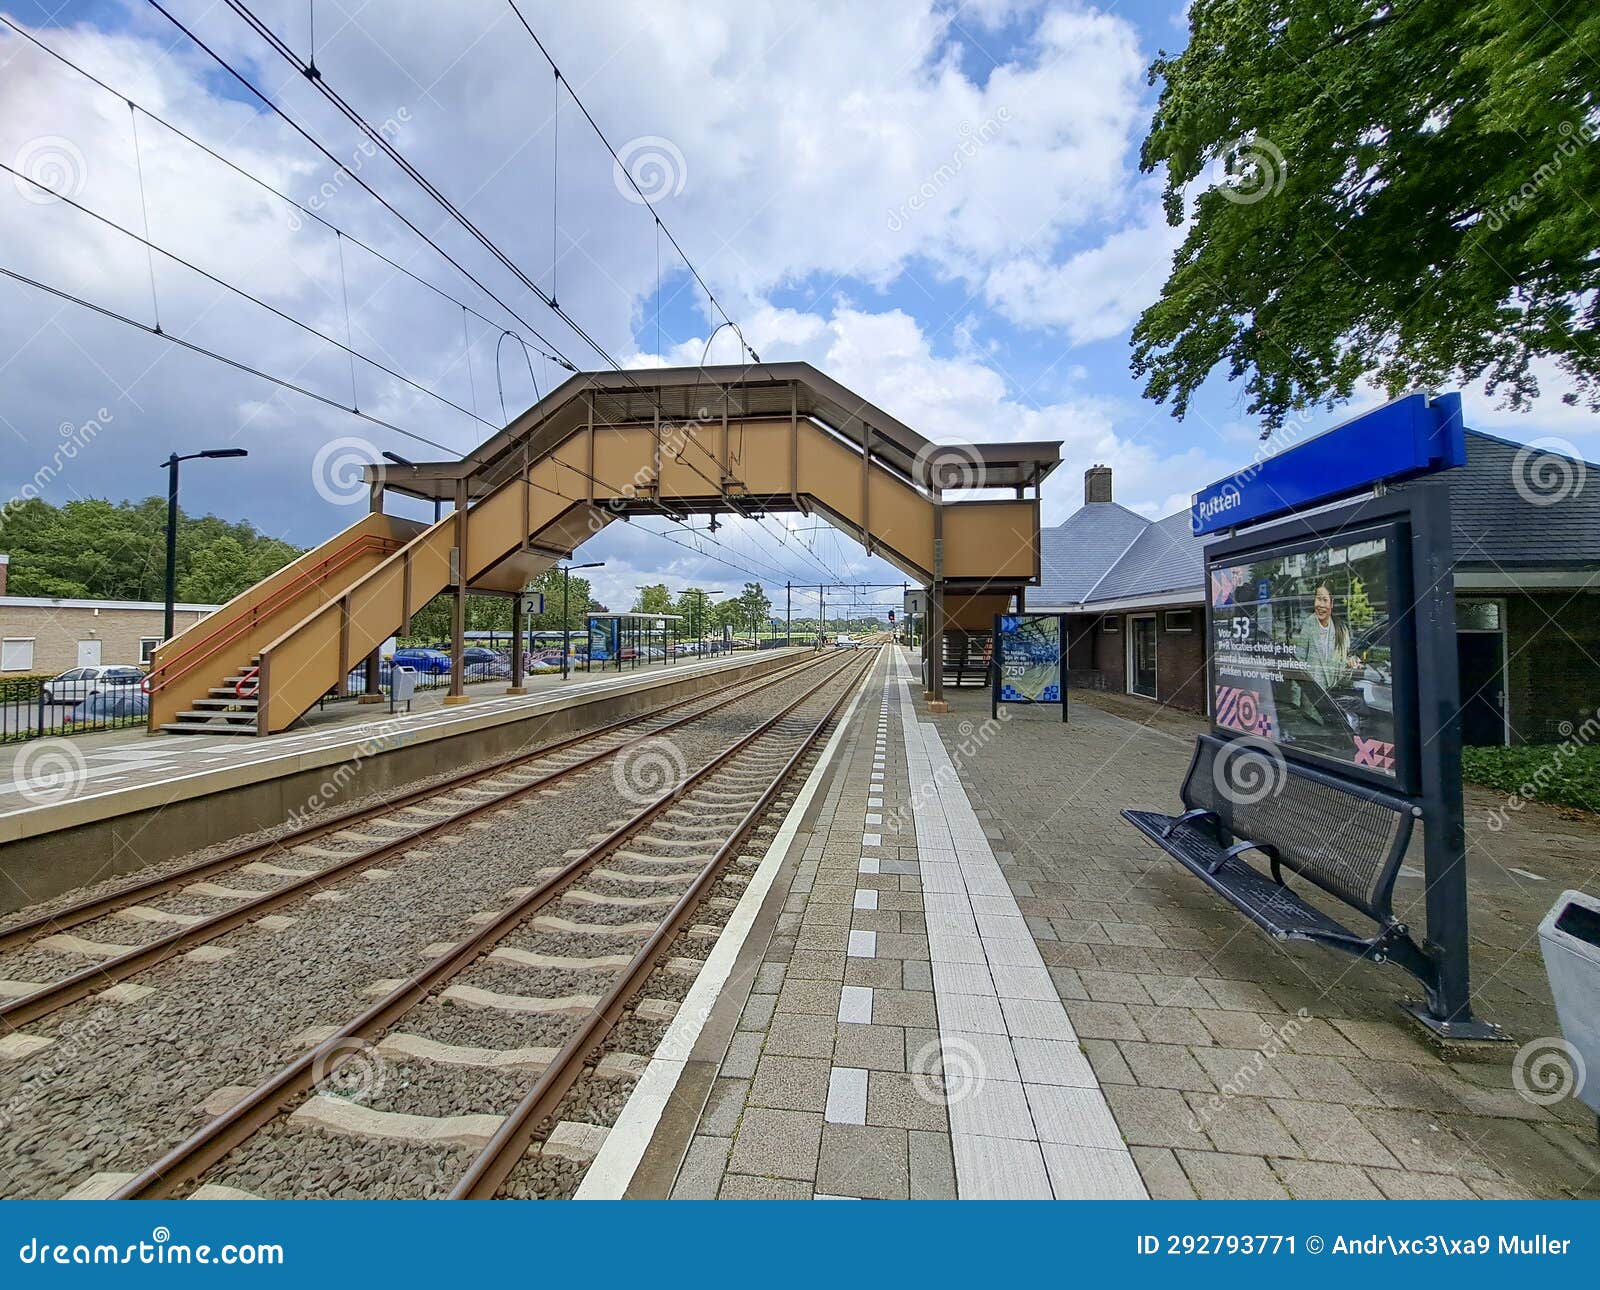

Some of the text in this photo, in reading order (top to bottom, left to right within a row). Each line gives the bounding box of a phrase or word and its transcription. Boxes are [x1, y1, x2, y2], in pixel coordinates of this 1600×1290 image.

[526, 601, 534, 612] 2
[912, 600, 918, 611] 1
[1218, 616, 1250, 639] Voor 53
[1253, 642, 1273, 653] check
[1273, 643, 1281, 655] je
[1282, 642, 1297, 654] het
[1277, 657, 1311, 670] parkeer-
[1005, 666, 1025, 676] 750
[1243, 670, 1259, 679] voor
[1260, 670, 1284, 682] vertrek
